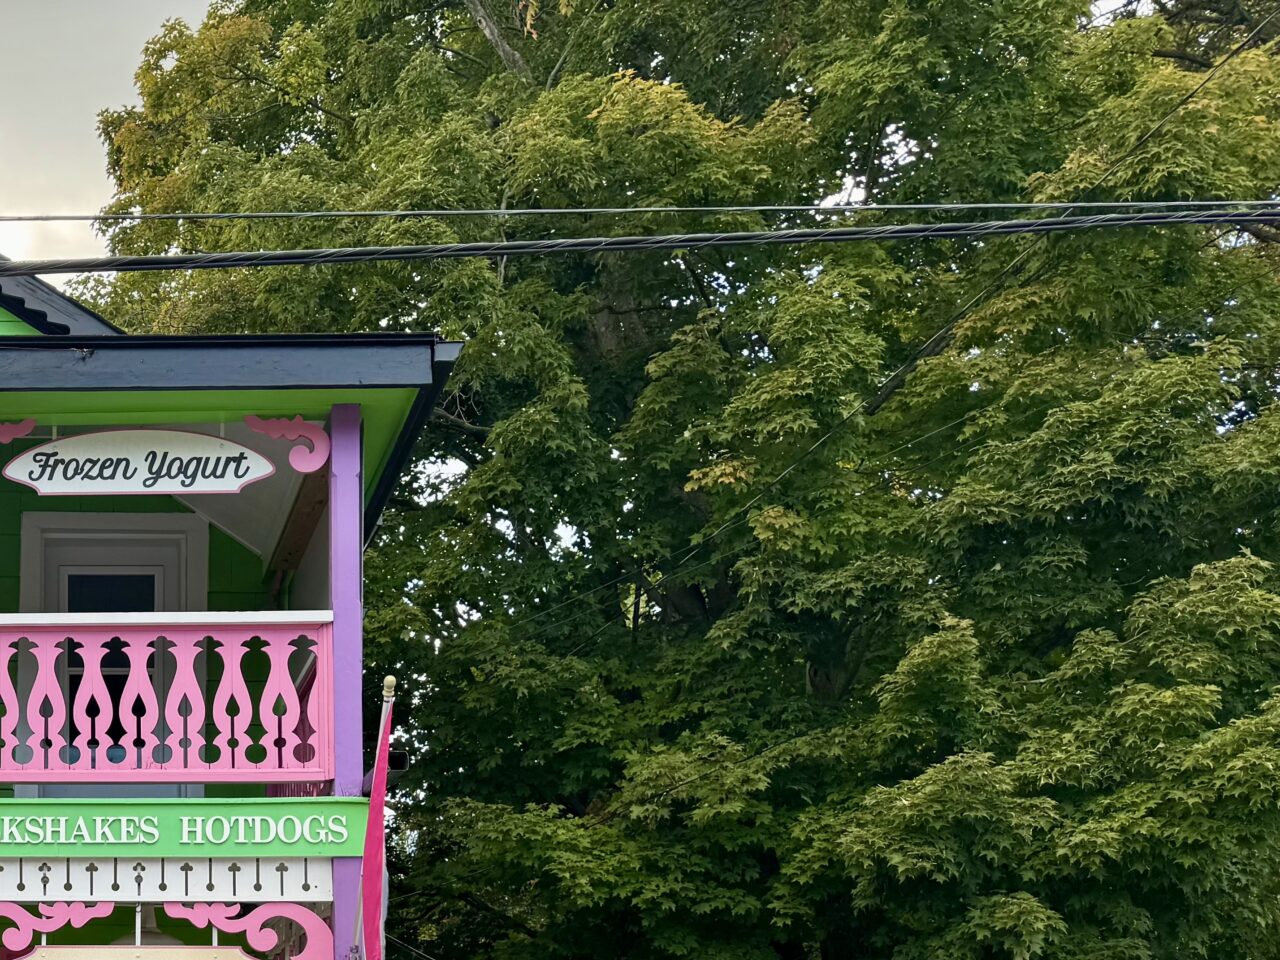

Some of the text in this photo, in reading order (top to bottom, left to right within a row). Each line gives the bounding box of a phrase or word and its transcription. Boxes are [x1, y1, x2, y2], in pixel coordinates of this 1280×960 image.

[28, 450, 250, 488] Frozen Yogurt
[179, 815, 349, 844] HOTDOGS
